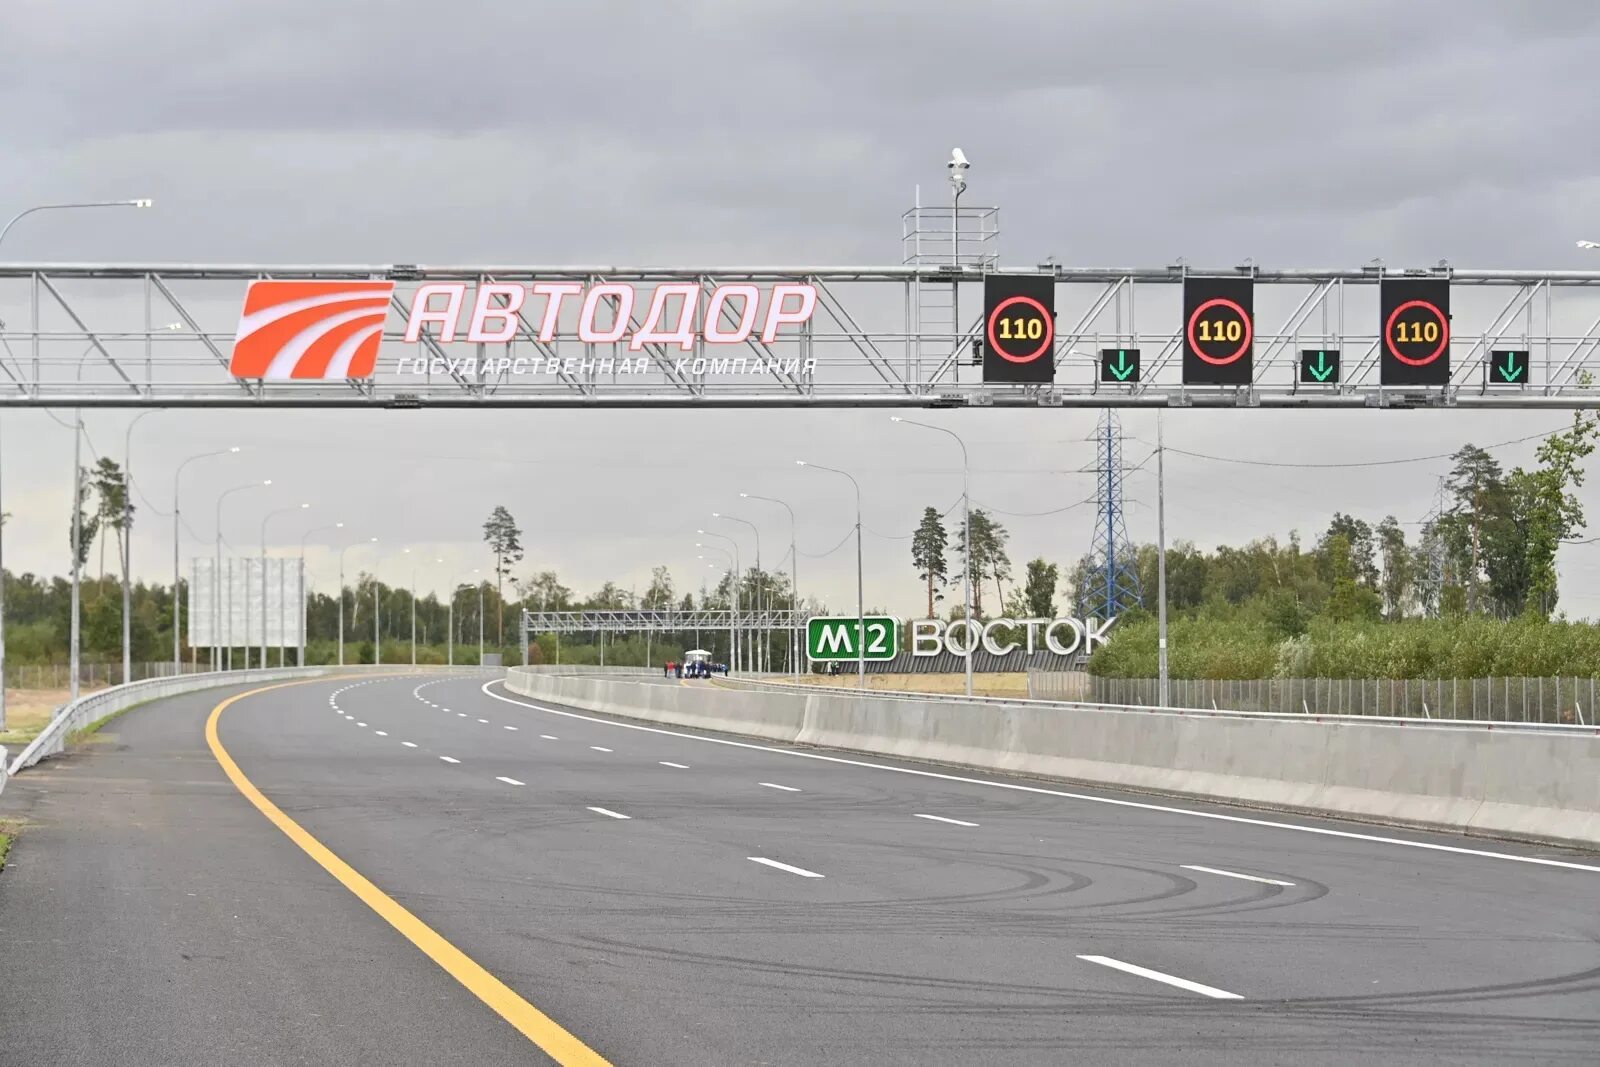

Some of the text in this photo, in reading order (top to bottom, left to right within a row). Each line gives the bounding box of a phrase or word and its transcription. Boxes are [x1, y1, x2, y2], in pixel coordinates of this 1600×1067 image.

[404, 283, 817, 351] АВТОДОР
[998, 318, 1042, 340] 110
[1199, 320, 1242, 341] 110
[1396, 322, 1438, 342] 110
[396, 357, 817, 376] ГОСУДАРСТВЕННАЯ КОМПАНИЯ
[912, 617, 1117, 657] ВОСТОК
